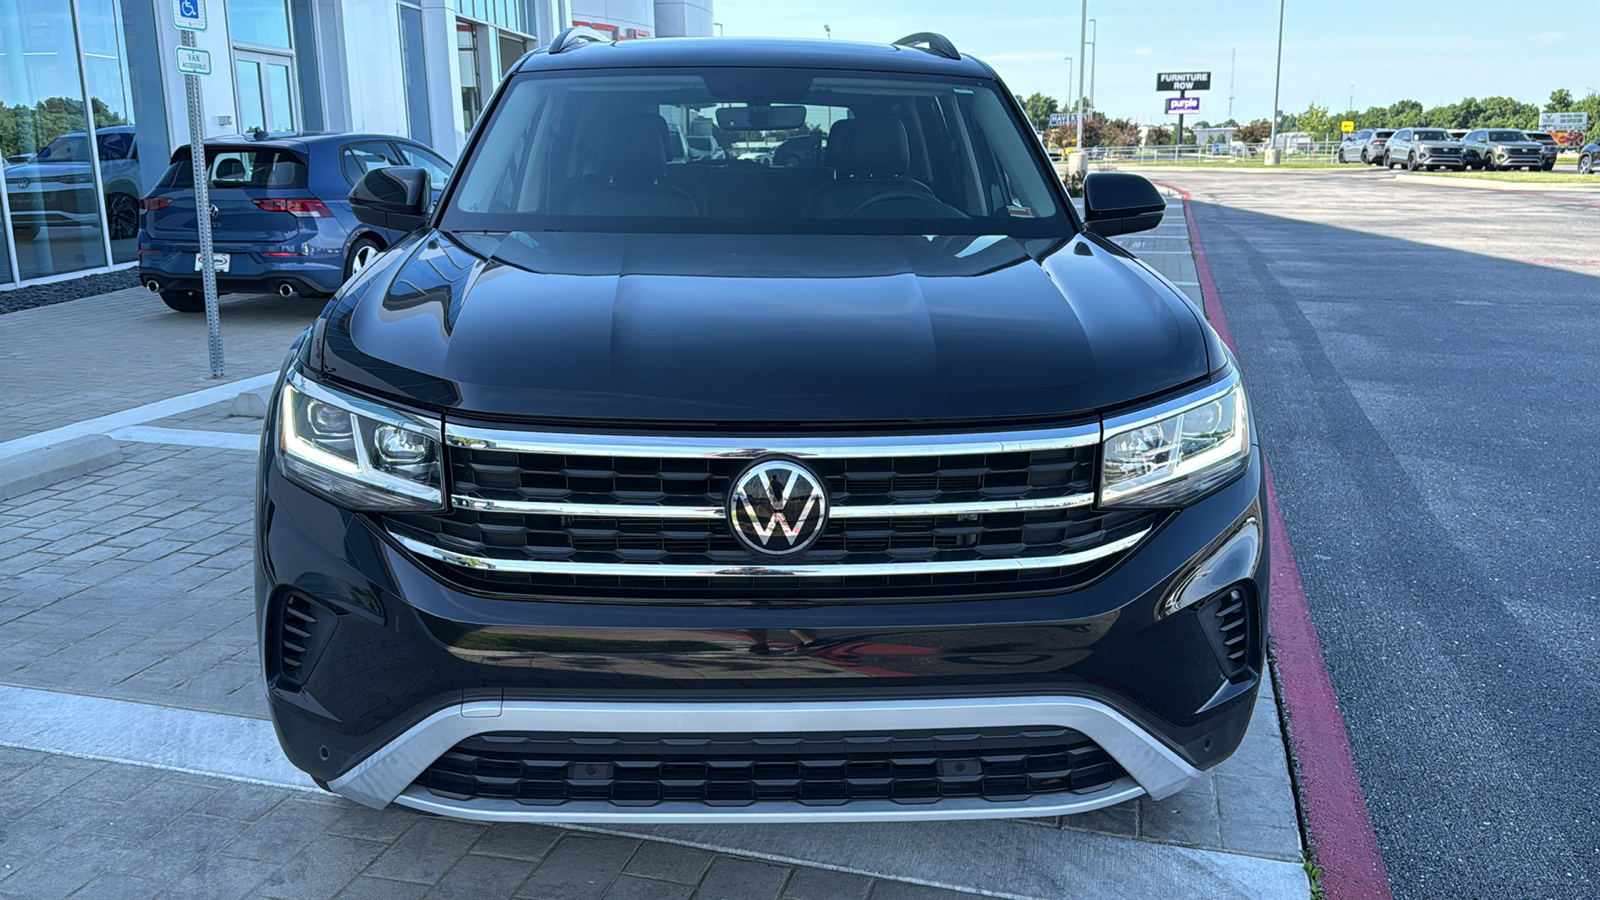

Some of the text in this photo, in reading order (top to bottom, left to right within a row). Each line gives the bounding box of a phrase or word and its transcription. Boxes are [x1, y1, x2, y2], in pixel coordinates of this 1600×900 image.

[187, 53, 200, 62] VAN
[182, 62, 206, 70] ACCESSIBLE
[1160, 73, 1208, 82] FURNITURE
[1173, 82, 1194, 90] ROW
[1170, 98, 1198, 109] purple
[733, 463, 823, 550] VW
